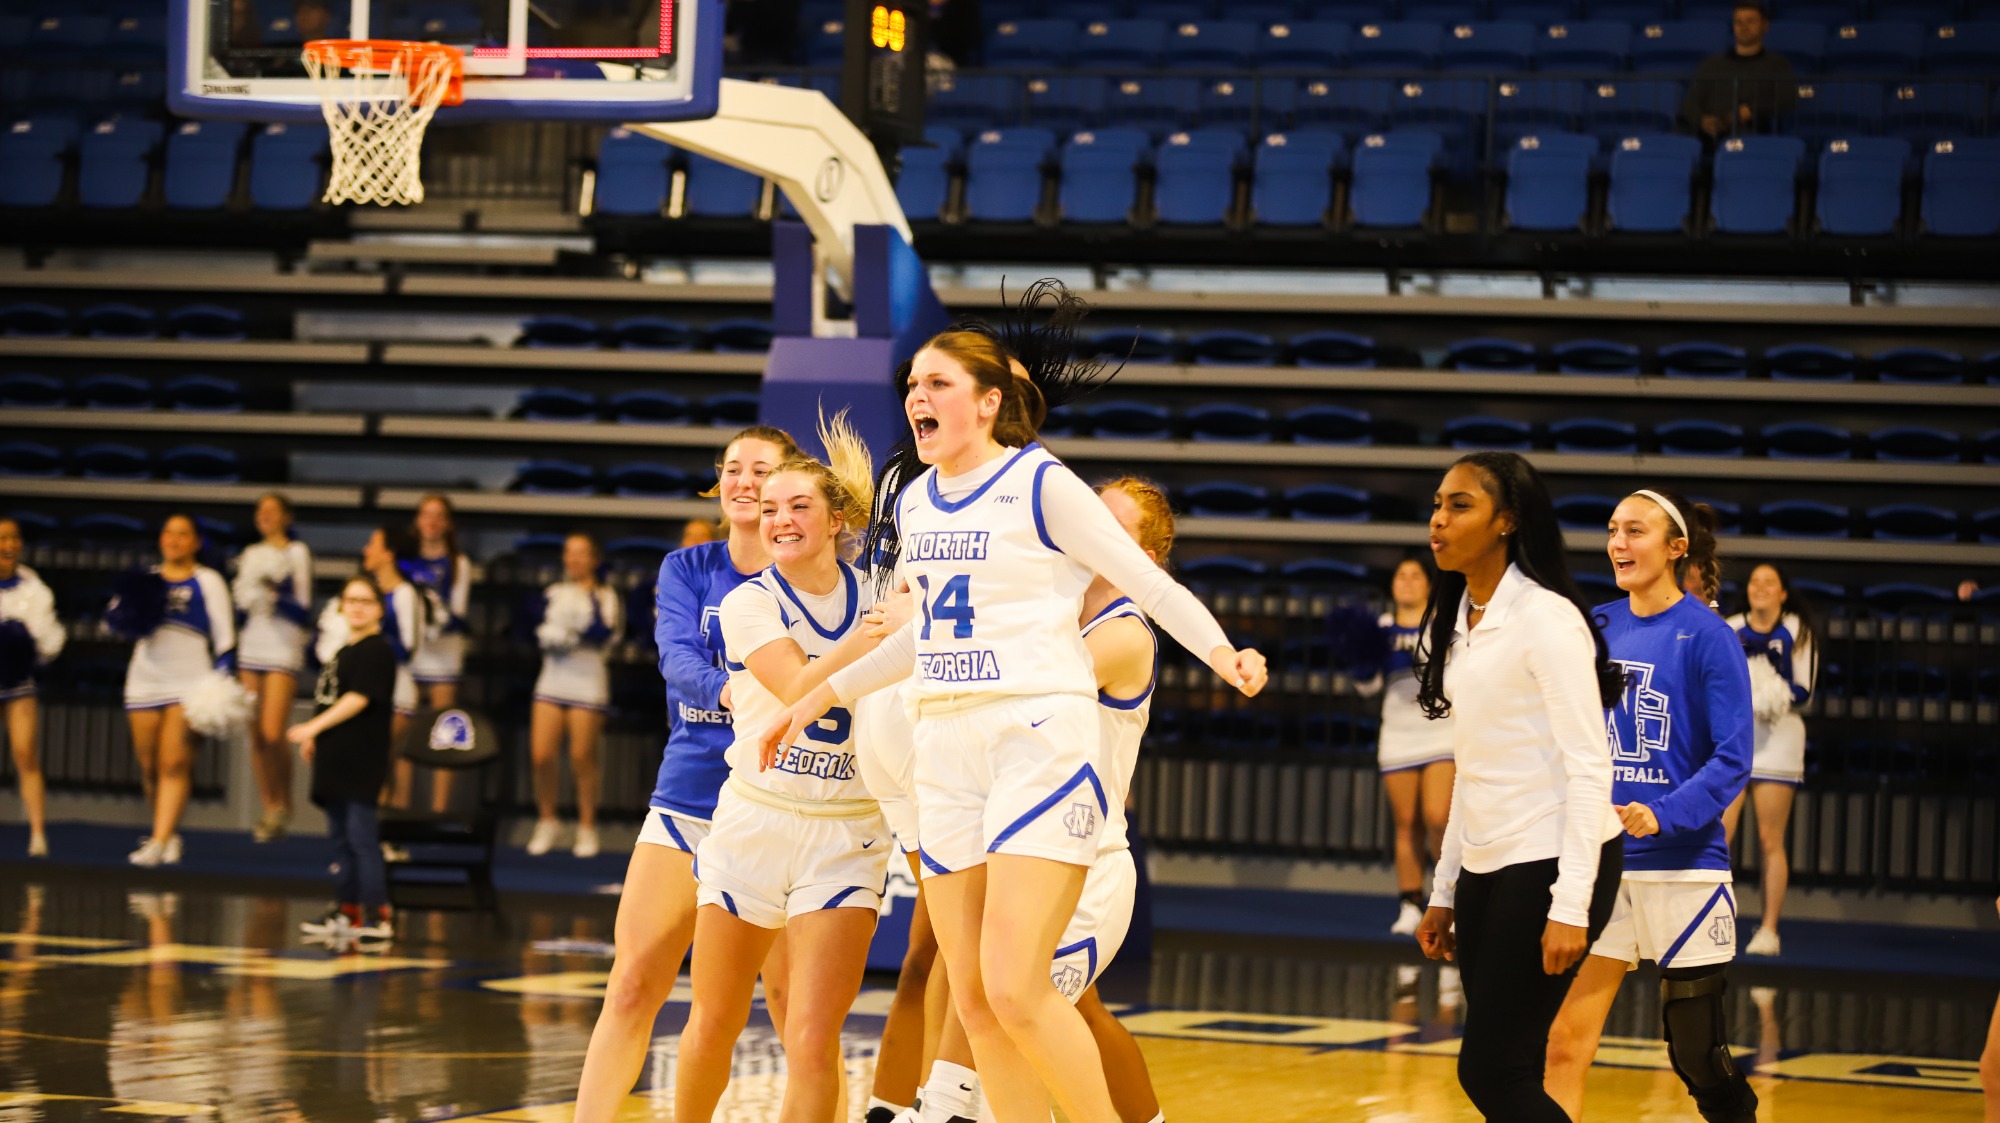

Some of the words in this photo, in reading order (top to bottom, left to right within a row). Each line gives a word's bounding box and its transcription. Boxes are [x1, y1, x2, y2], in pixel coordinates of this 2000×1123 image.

[905, 531, 990, 563] NORTH
[916, 574, 976, 640] 14
[917, 650, 1001, 682] EORGIA
[1613, 765, 1670, 785] TBALL
